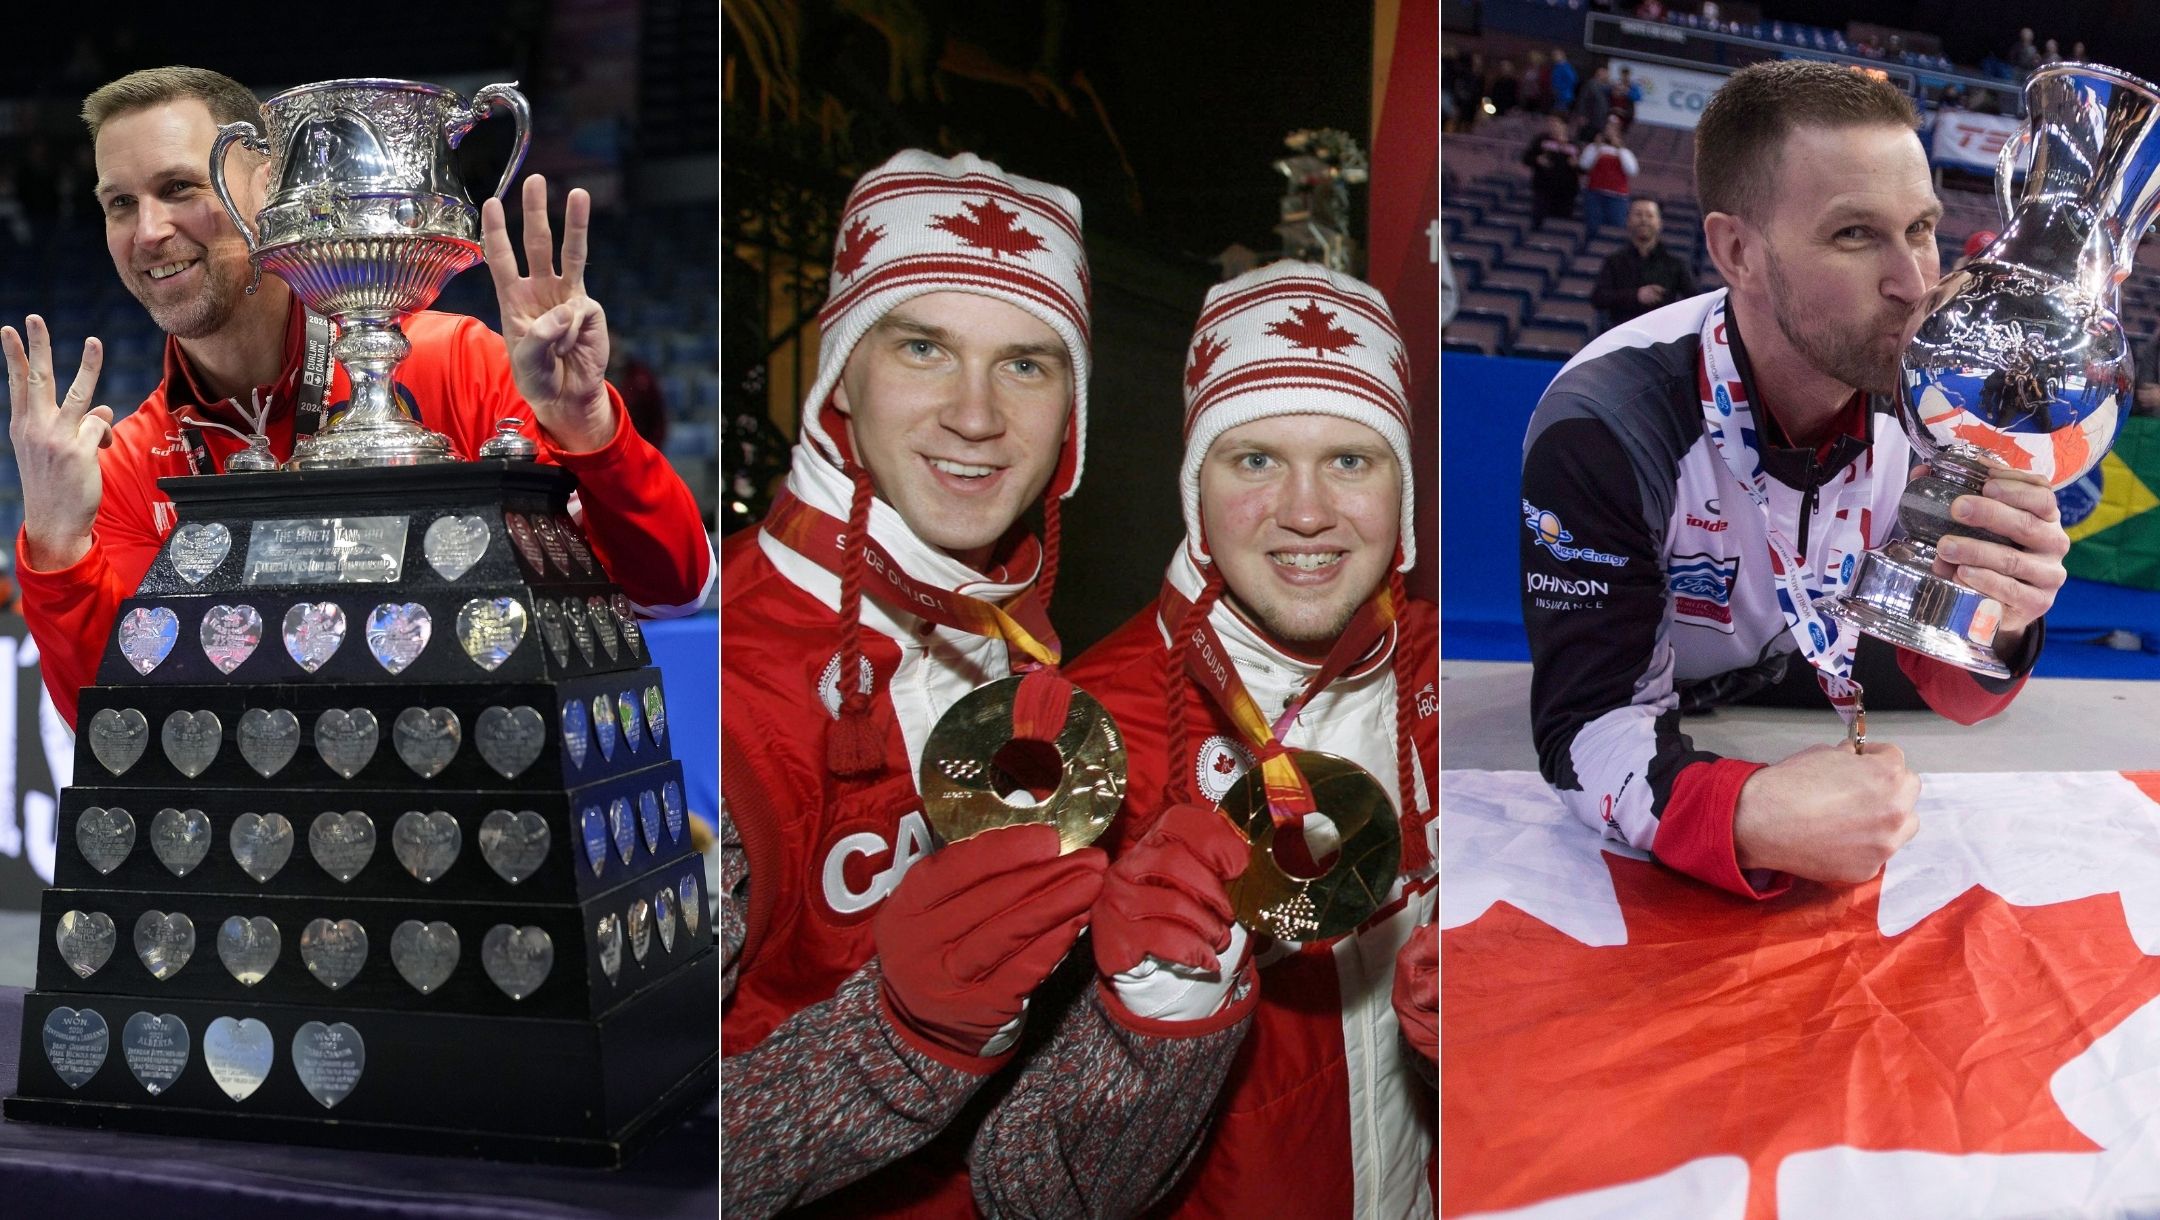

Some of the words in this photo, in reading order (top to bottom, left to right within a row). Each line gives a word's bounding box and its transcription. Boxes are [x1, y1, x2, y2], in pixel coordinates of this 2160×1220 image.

[1668, 90, 1704, 111] CO
[1425, 219, 1438, 263] t
[308, 315, 329, 327] 2024
[307, 339, 318, 371] CURLING
[315, 344, 326, 373] CANADA
[300, 402, 322, 413] 2024
[273, 528, 293, 543] THE
[1581, 549, 1629, 567] Energy
[1527, 572, 1609, 596] JOHNSON
[1676, 579, 1727, 600] Ford
[1536, 597, 1604, 611] INSURANCE
[1191, 628, 1206, 649] 20
[1202, 643, 1228, 690] torino
[1417, 695, 1438, 720] HBC
[822, 810, 936, 914] CA
